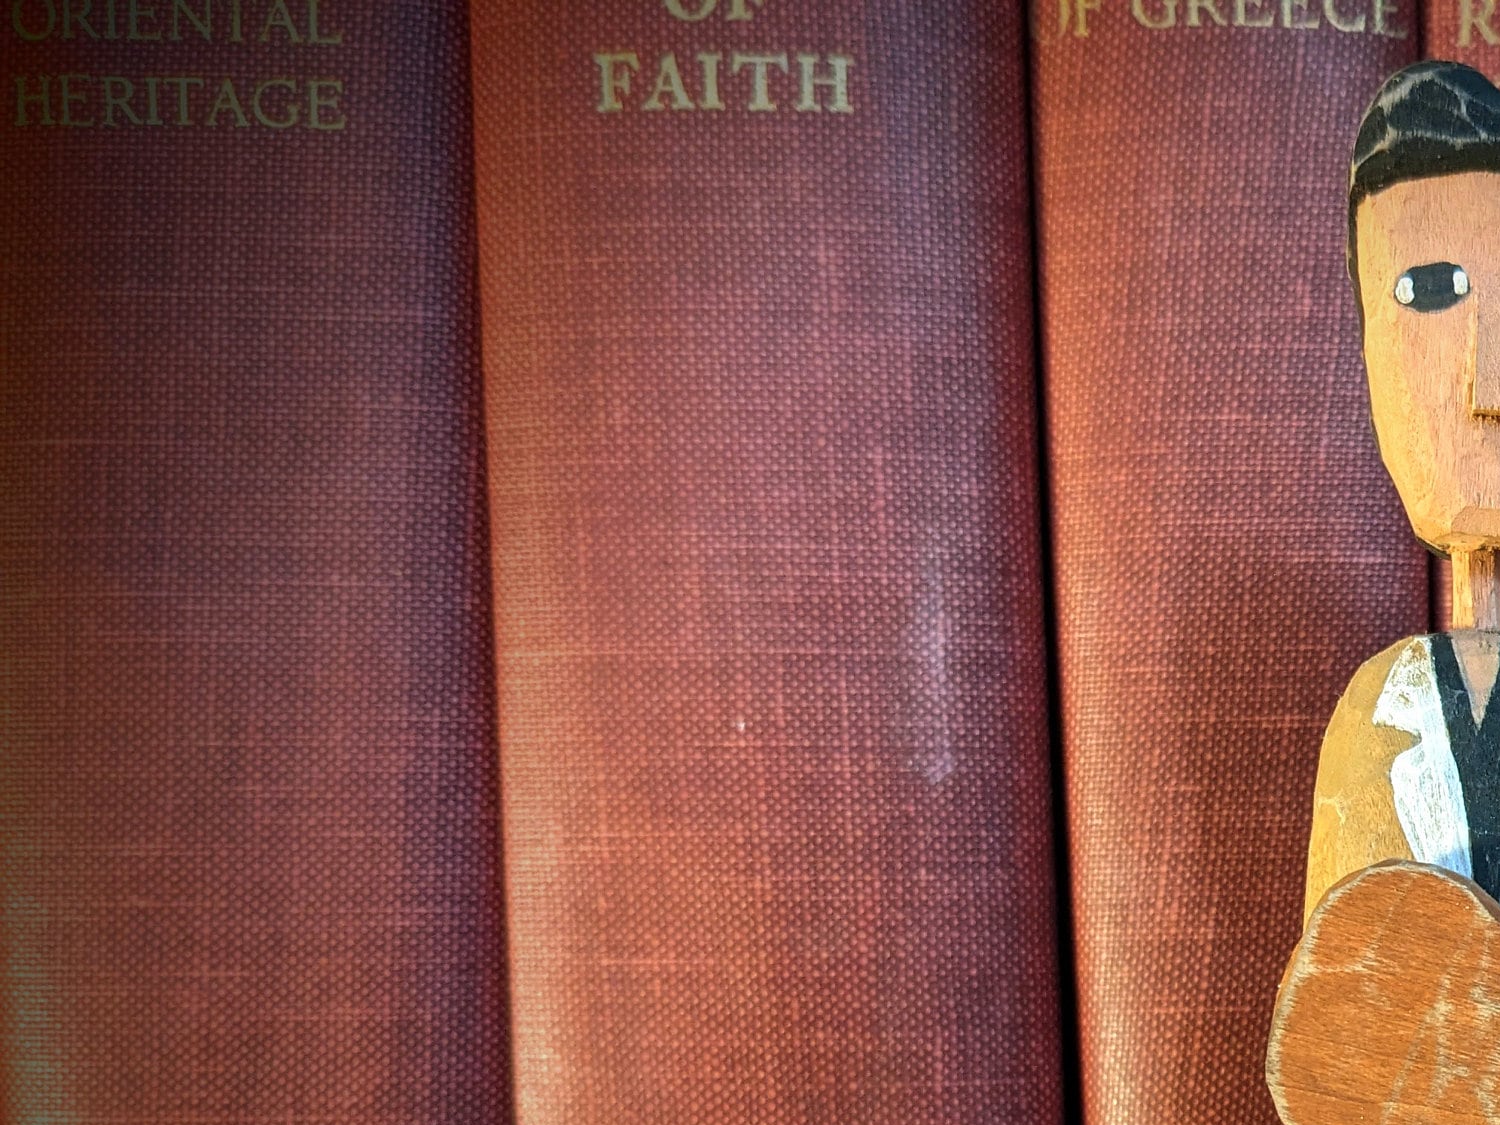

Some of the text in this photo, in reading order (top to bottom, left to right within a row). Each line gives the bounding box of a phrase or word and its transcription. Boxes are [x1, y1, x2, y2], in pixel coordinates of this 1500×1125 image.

[12, 0, 343, 44] ORIENTAL
[1130, 0, 1406, 38] GREECE
[14, 74, 345, 129] HERITAGE
[593, 51, 855, 114] FAITH
